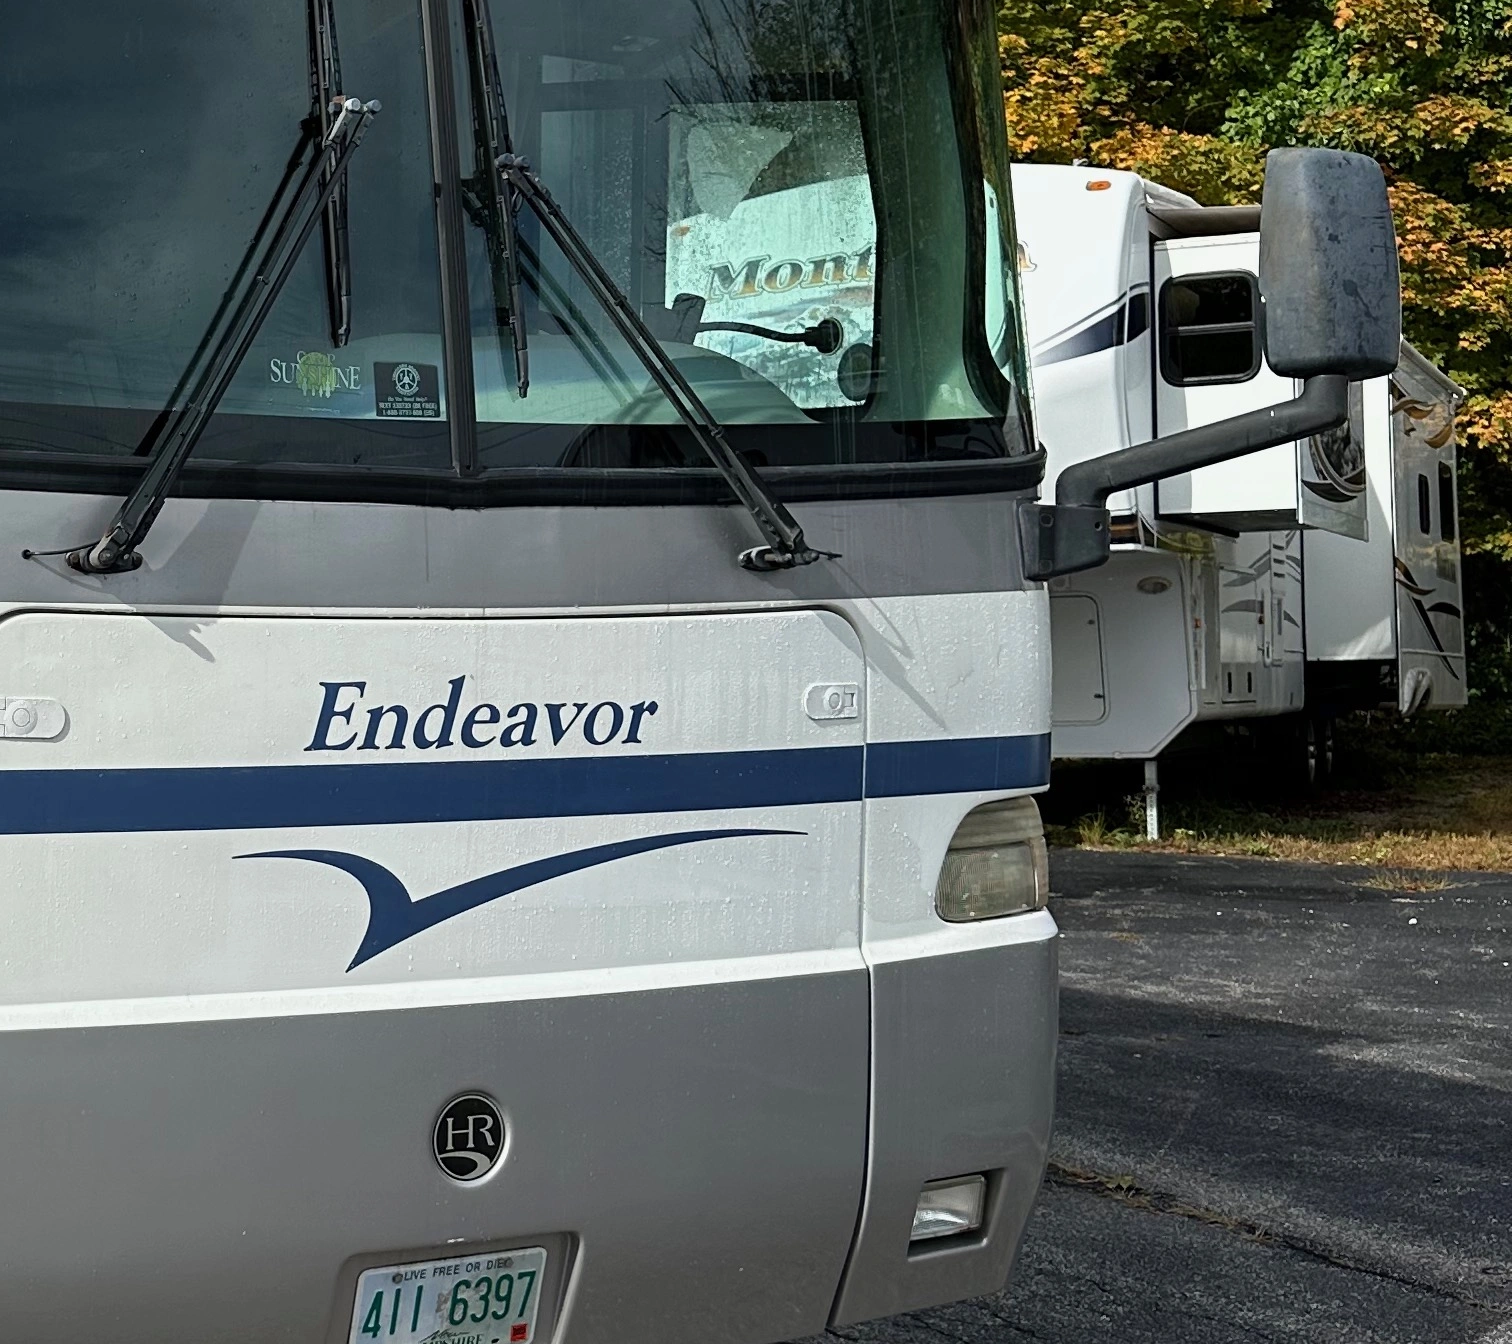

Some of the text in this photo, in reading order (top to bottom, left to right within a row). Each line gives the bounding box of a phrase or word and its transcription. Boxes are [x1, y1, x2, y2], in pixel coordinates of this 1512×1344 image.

[270, 358, 361, 389] SUNSHINE
[303, 674, 659, 752] Endeavor
[445, 1114, 495, 1150] HR
[403, 1258, 504, 1282] LIVE FREE OR DIE
[361, 1270, 537, 1339] 411 6397
